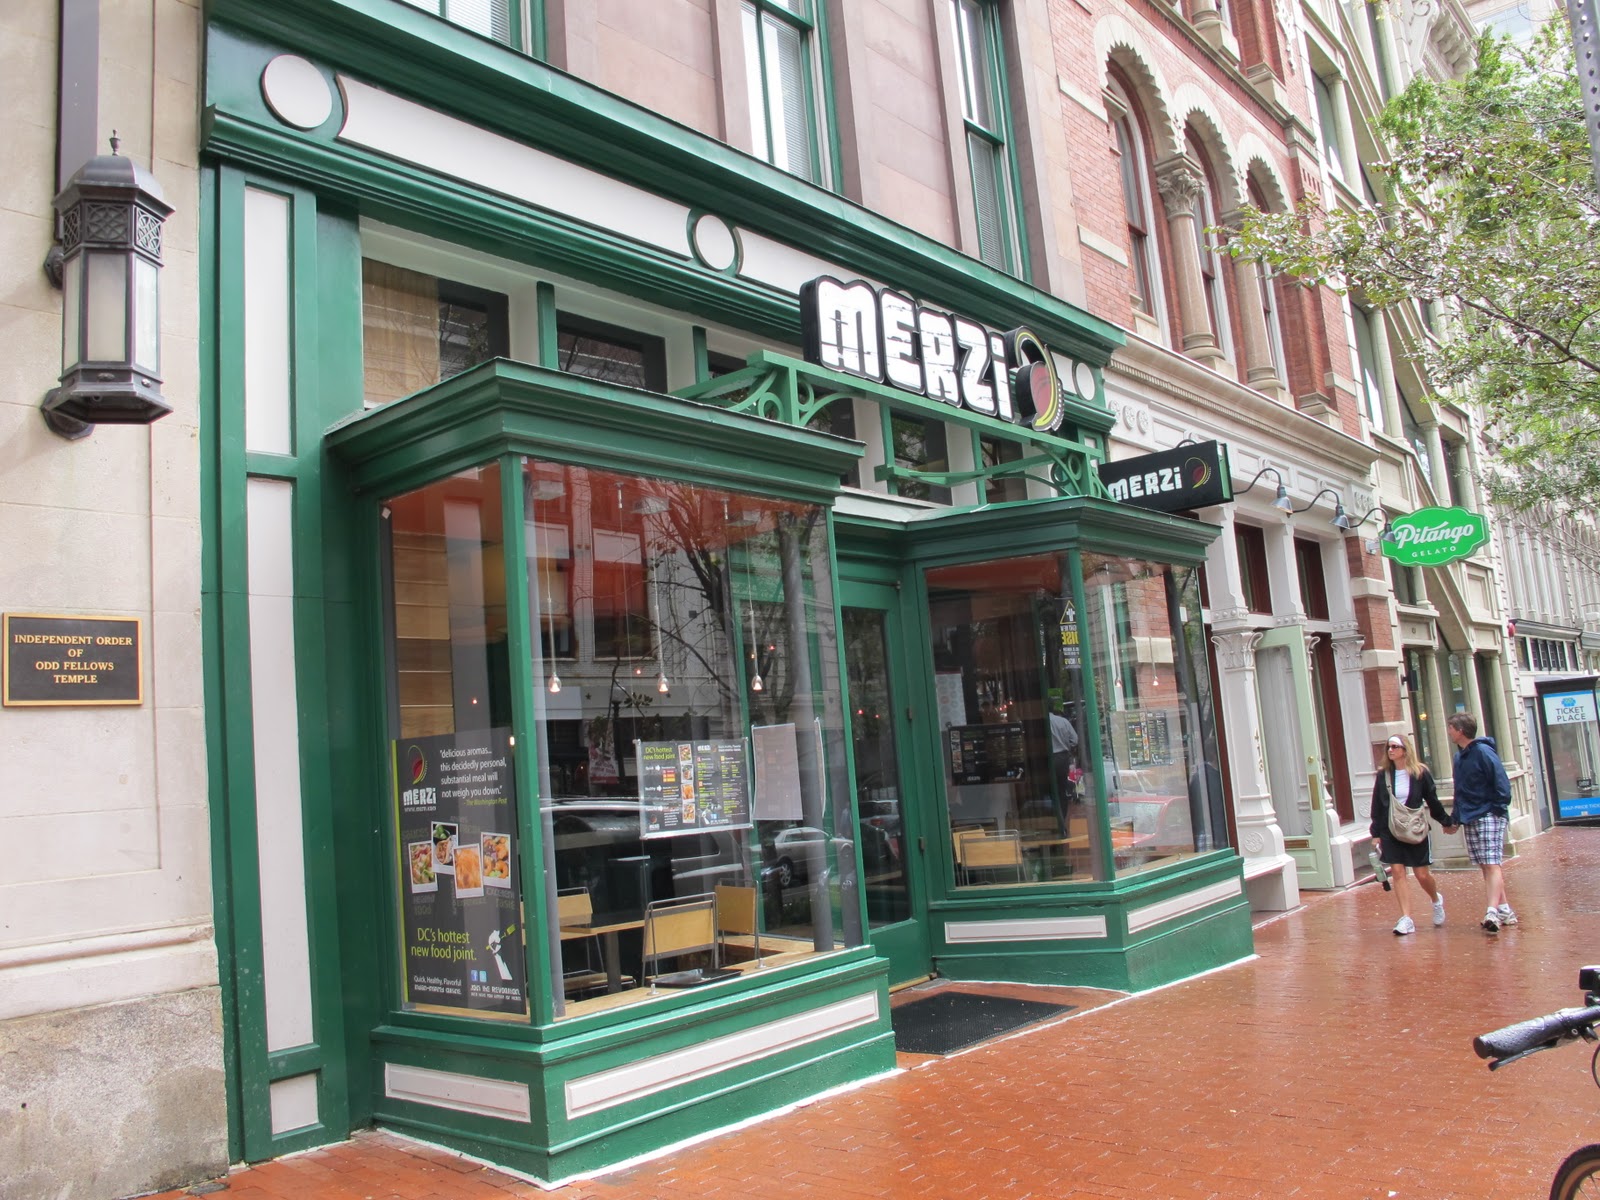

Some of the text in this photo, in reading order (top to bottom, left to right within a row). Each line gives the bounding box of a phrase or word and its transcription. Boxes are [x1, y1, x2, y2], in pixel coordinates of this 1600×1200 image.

[1394, 521, 1474, 549] Pitango
[1411, 546, 1457, 558] GELATO
[14, 634, 133, 646] INDEPENDENT ORDER
[67, 648, 84, 658] OF
[35, 661, 114, 671] ODD FELLOWS
[53, 674, 98, 684] TEMPLE
[1555, 706, 1585, 715] TICKET
[1556, 713, 1587, 722] PLACE
[440, 757, 507, 772] this decidedly personal,
[440, 771, 499, 785] substantial meal will
[441, 789, 452, 798] not
[452, 787, 470, 799] weigh
[470, 788, 482, 799] you
[417, 928, 470, 944] DC's hottest
[411, 943, 477, 963] new food joint.
